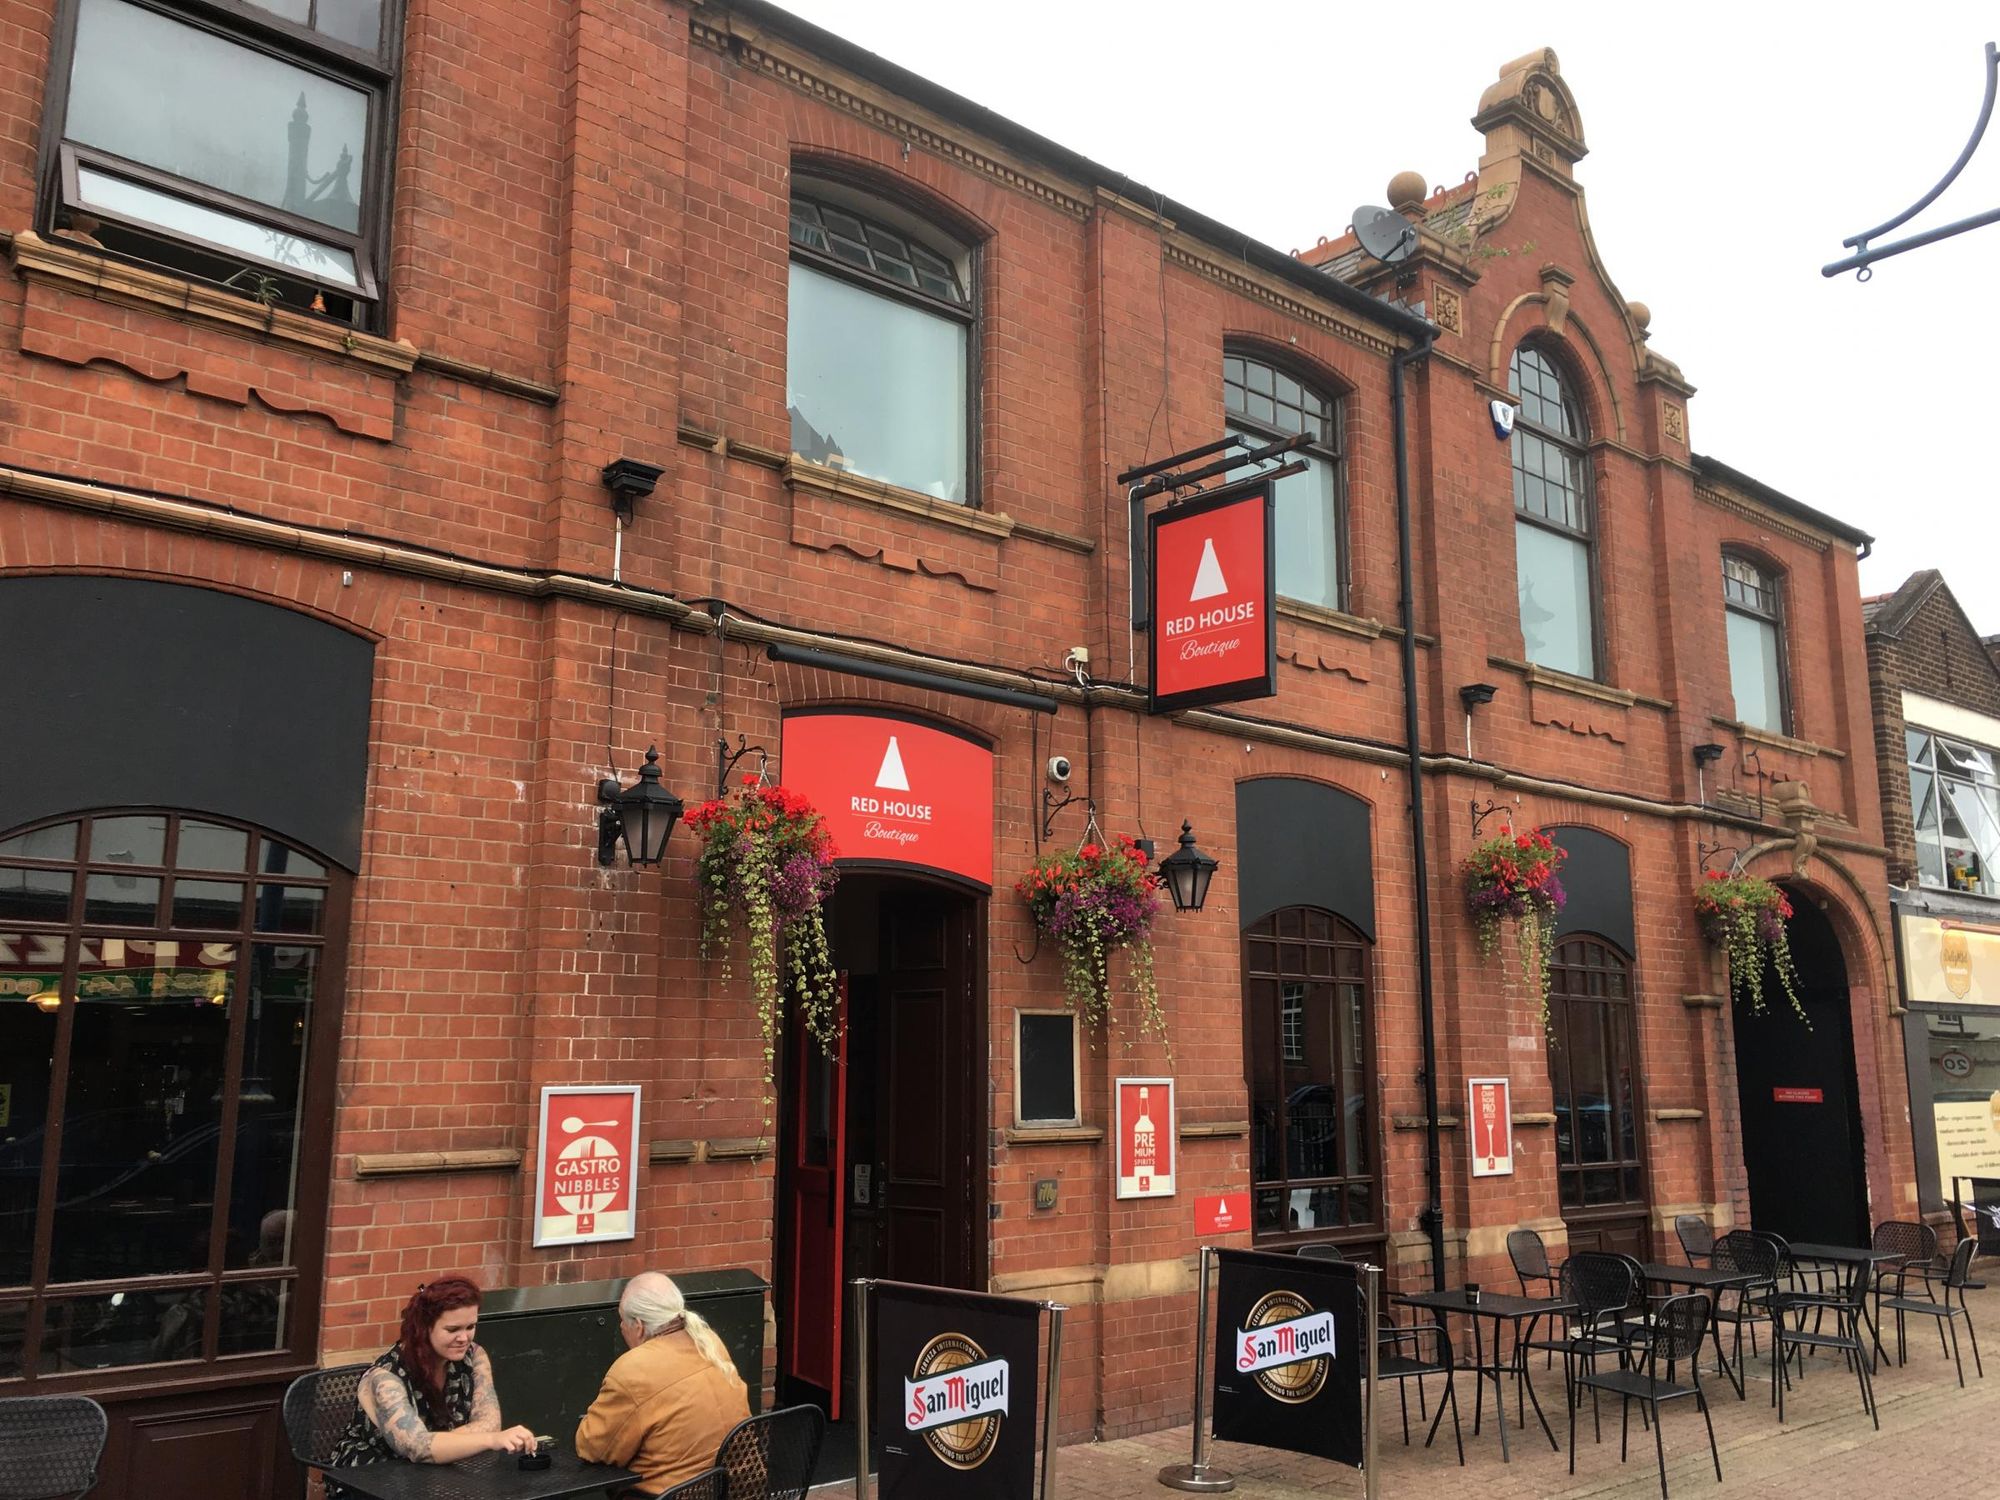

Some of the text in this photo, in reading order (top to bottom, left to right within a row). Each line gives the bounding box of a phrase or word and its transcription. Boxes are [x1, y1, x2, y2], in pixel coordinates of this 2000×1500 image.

[1166, 602, 1255, 636] RED HOUSE
[1180, 638, 1240, 660] Boutique
[851, 796, 931, 820] RED HOUSE
[864, 821, 919, 846] Boutique
[1483, 1103, 1496, 1113] PRO
[1134, 1133, 1155, 1147] PRE
[1134, 1147, 1155, 1158] MIUM
[1134, 1158, 1155, 1166] SPIRITS
[555, 1158, 621, 1176] GASTRO
[554, 1177, 620, 1195] NIBBLES
[1251, 1304, 1268, 1326] CERVEZA
[1239, 1320, 1330, 1368] San Miguel
[919, 1341, 979, 1375] CERVEZA INTERNACIONAL
[1260, 1373, 1285, 1395] EXPLORING
[1286, 1389, 1295, 1397] THE
[908, 1370, 1003, 1425] San Miguel
[929, 1432, 955, 1460] EXPLORING
[955, 1451, 965, 1462] THE
[965, 1448, 982, 1462] WORLD
